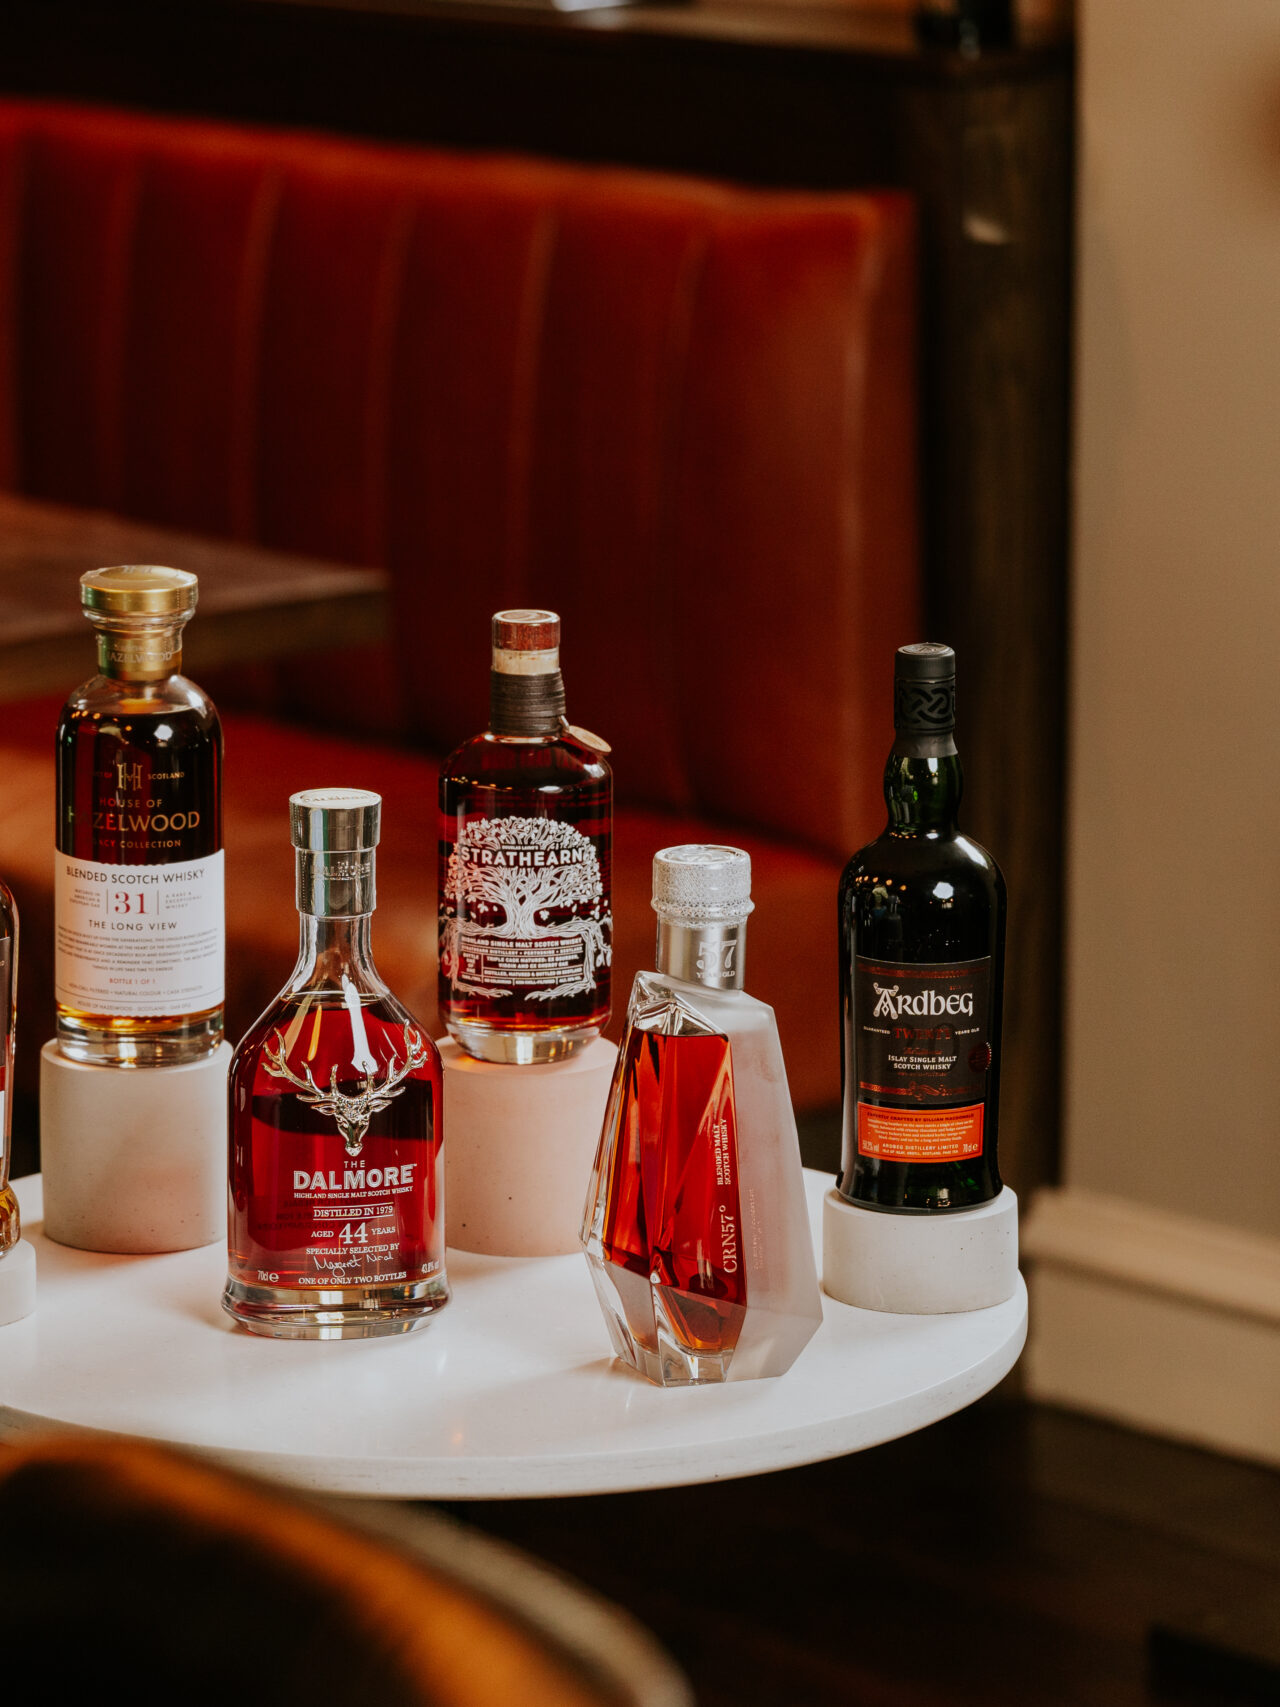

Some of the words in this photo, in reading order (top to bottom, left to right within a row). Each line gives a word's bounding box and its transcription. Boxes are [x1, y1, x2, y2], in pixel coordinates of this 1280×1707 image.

[100, 798, 140, 808] HOUSE
[146, 800, 162, 808] OF
[120, 840, 182, 848] COLLECTION
[461, 847, 583, 866] STRATHEARN
[66, 866, 108, 882] BLENDED
[112, 874, 159, 884] SCOTCH
[162, 869, 206, 882] WHISKY
[114, 892, 148, 914] 31
[89, 920, 106, 929] THE
[111, 922, 144, 931] LONG
[149, 922, 178, 930] VIEW
[490, 940, 514, 948] SINGLE
[534, 940, 560, 948] SCOTCH
[696, 940, 737, 970] 57
[722, 970, 736, 978] OLD
[895, 1027, 951, 1040] TWENTY
[720, 1118, 728, 1152] WHISKY
[344, 1160, 366, 1168] THE
[714, 1147, 724, 1186] BLENDED
[723, 1152, 731, 1185] SCOTCH
[294, 1164, 414, 1190] DALMORE
[392, 1186, 414, 1194] WHISKY
[314, 1208, 362, 1218] DISTILLED
[364, 1208, 374, 1216] IN
[376, 1206, 393, 1214] 1979
[339, 1222, 368, 1244] 44
[372, 1226, 396, 1235] YEARS
[350, 1245, 388, 1254] SELECTED
[390, 1242, 400, 1250] BY
[354, 1276, 372, 1284] TWO
[374, 1272, 406, 1281] BOTTLES
